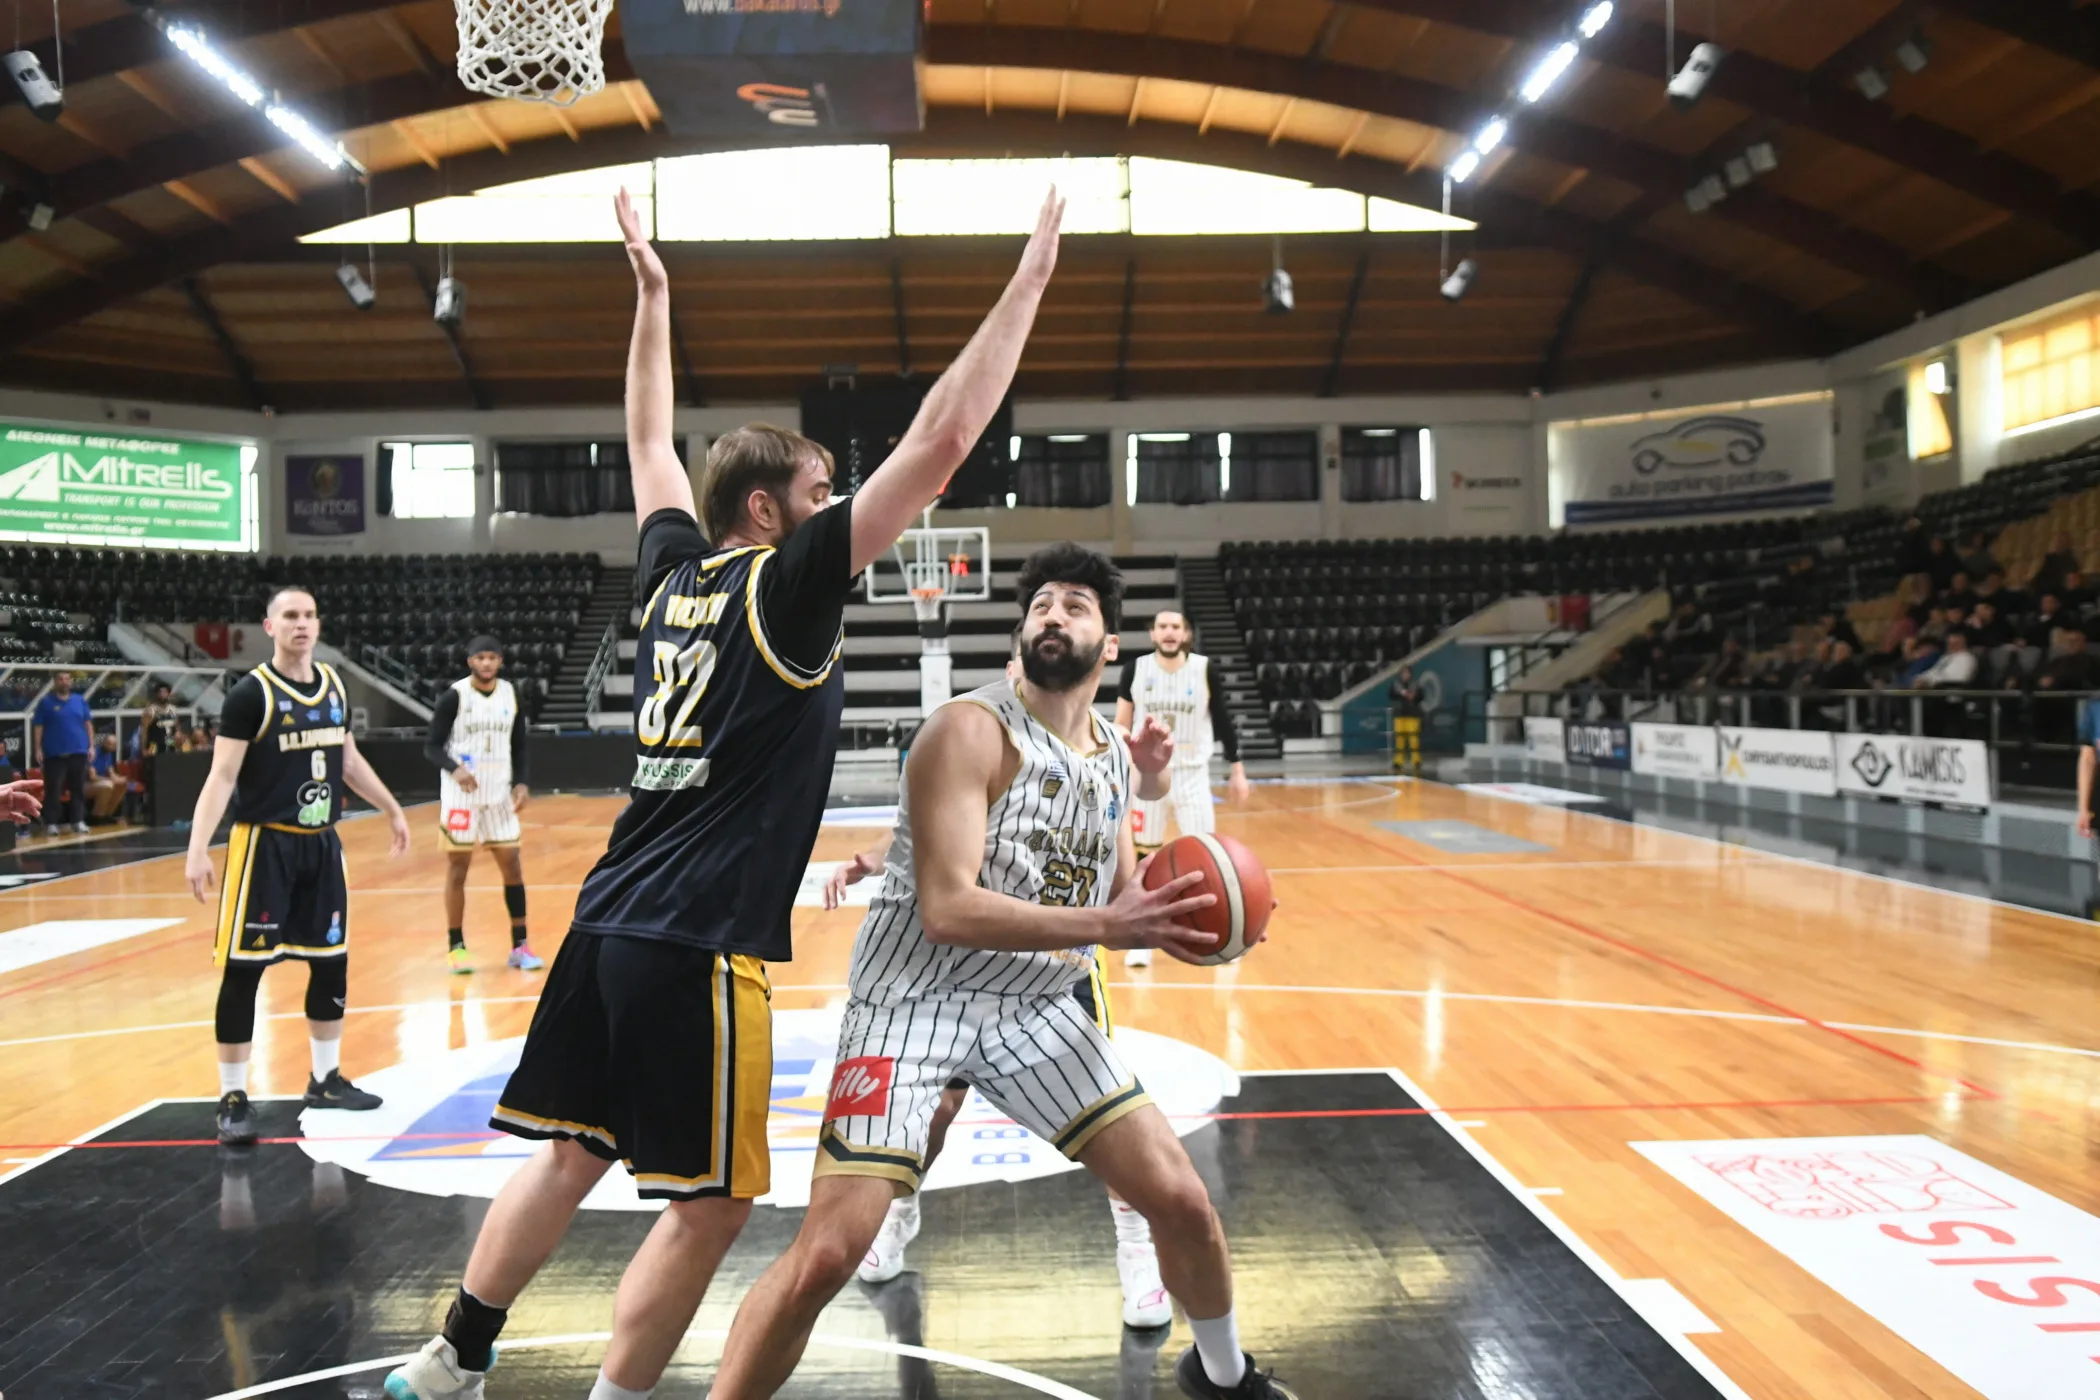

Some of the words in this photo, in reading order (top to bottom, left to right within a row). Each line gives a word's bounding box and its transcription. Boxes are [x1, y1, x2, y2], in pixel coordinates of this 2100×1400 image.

[311, 750, 327, 781] 6
[298, 780, 332, 806] GO
[832, 1066, 880, 1104] illy
